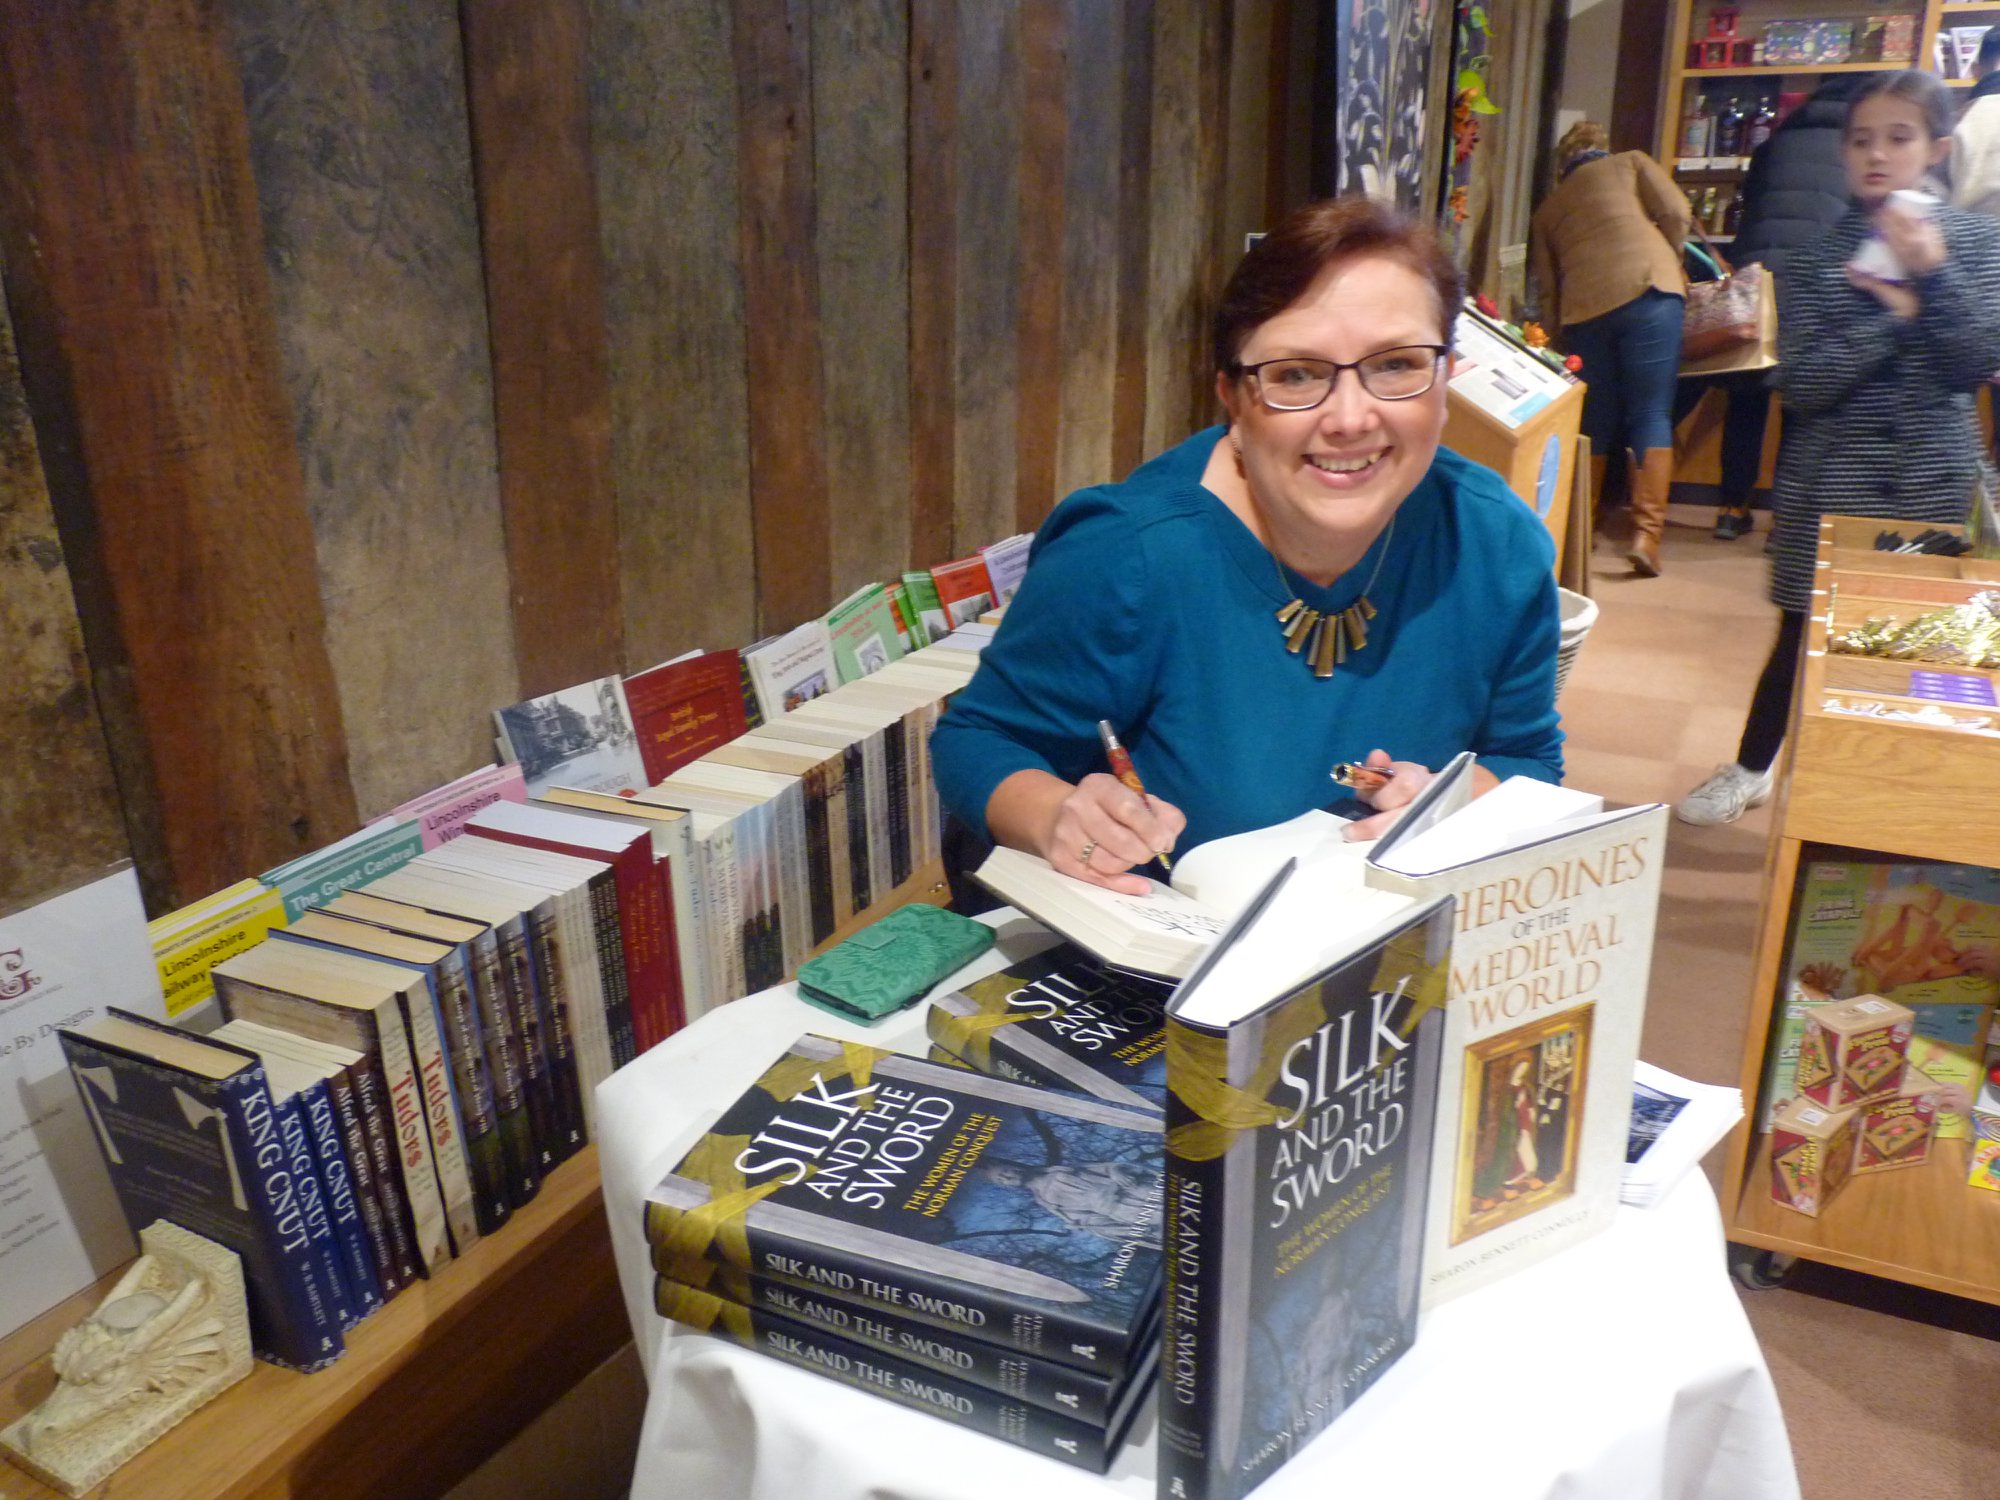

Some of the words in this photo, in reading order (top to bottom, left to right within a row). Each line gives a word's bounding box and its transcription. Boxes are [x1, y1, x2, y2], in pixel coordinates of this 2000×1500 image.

[425, 788, 502, 832] Lincolnshire
[288, 891, 319, 913] The
[320, 869, 362, 897] Great
[363, 843, 418, 878] Central
[1454, 836, 1649, 934] HEROINES
[162, 930, 247, 978] Lincolnshire
[1447, 914, 1623, 1001] MEDIEVAL
[1511, 918, 1535, 939] OF
[1538, 906, 1571, 931] THE
[163, 967, 208, 1000] ailway
[1048, 999, 1114, 1035] AND
[1467, 959, 1603, 1031] WORLD
[1069, 998, 1165, 1051] SWOR
[1111, 1043, 1138, 1060] THE
[1134, 1027, 1168, 1047] WOM
[1276, 974, 1413, 1130] SILK
[356, 1071, 380, 1119] Alfred
[423, 1048, 453, 1148] Tudors
[997, 1060, 1023, 1079] SILK
[280, 1109, 313, 1177] KING
[336, 1086, 359, 1132] Alfred
[346, 1132, 363, 1153] the
[366, 1117, 383, 1138] the
[392, 1069, 424, 1169] Tudors
[734, 1072, 881, 1185] SILK
[805, 1138, 871, 1200] AND
[851, 1086, 916, 1132] THE
[1270, 1104, 1344, 1179] AND
[1350, 1057, 1408, 1121] THE
[240, 1086, 284, 1171] KING
[264, 1170, 312, 1254] CNUT
[309, 1094, 339, 1160] KING
[324, 1159, 358, 1226] CNUT
[352, 1150, 371, 1188] Great
[371, 1136, 389, 1175] Great
[841, 1096, 954, 1210] SWORD
[902, 1189, 931, 1211] THE
[920, 1147, 961, 1187] WOMEN
[951, 1132, 970, 1147] OF
[962, 1112, 986, 1131] THE
[921, 1168, 967, 1218] NORMAN
[958, 1115, 1004, 1168] CONQUEST
[1270, 1102, 1405, 1229] SWORD
[296, 1176, 332, 1241] CNUT
[1180, 1178, 1203, 1224] SILK
[1275, 1231, 1330, 1277] NORMAN
[1331, 1181, 1392, 1235] CONQUEST
[1278, 1232, 1301, 1258] THE
[1303, 1198, 1351, 1236] WOMEN
[1352, 1180, 1370, 1199] OF
[1370, 1163, 1392, 1185] THE
[1104, 1239, 1138, 1290] SHARON
[1129, 1190, 1165, 1238] BENNETT
[1180, 1222, 1200, 1277] AND
[1429, 1258, 1478, 1285] SHARON
[764, 1253, 804, 1277] SILK
[805, 1264, 855, 1291] AND
[858, 1278, 903, 1305] THE
[907, 1292, 987, 1327] SWORD
[1178, 1284, 1199, 1327] THE
[764, 1285, 803, 1312] SILK
[802, 1300, 850, 1328] AND
[853, 1315, 894, 1344] THE
[898, 1332, 975, 1370] SWORD
[766, 1330, 805, 1357] SILK
[804, 1345, 852, 1373] AND
[854, 1361, 897, 1389] THE
[899, 1377, 975, 1416] SWORD
[1175, 1332, 1197, 1405] SWORD
